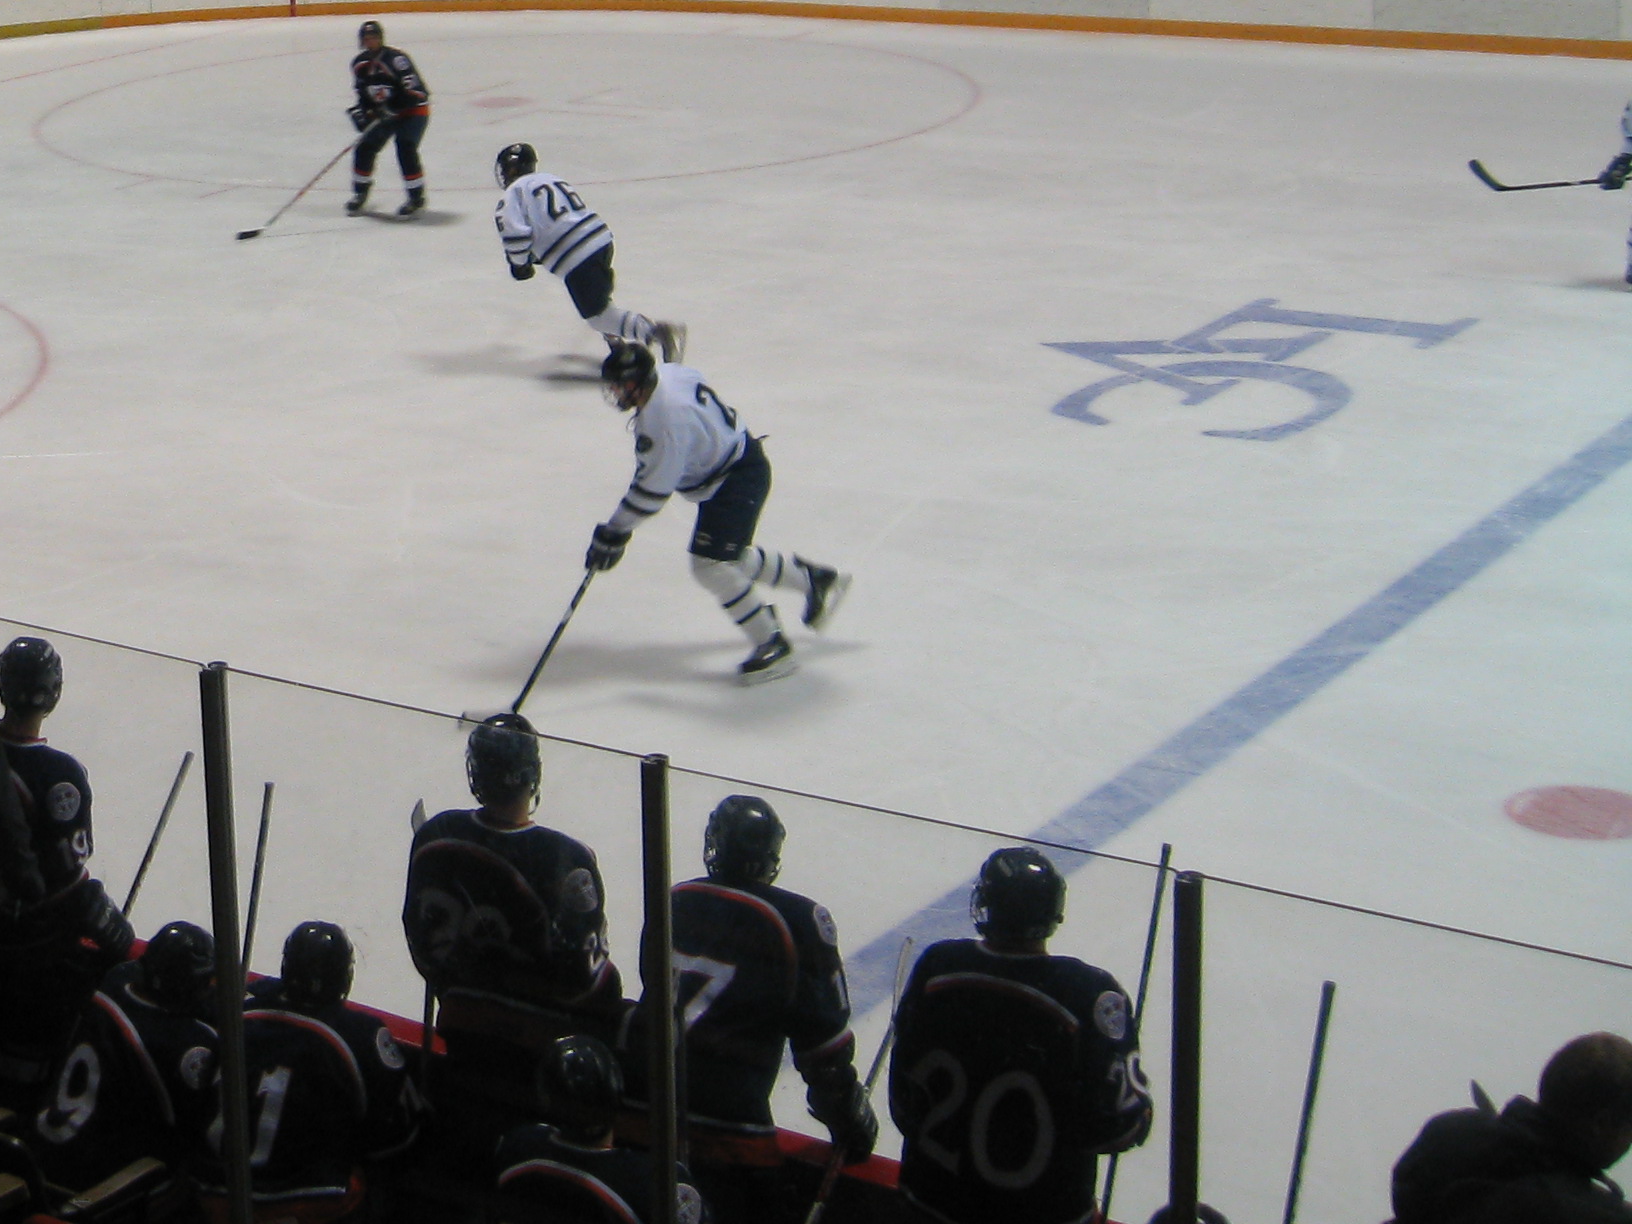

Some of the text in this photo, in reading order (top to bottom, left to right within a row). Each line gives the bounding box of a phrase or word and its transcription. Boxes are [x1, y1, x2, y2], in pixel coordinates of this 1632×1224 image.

[532, 181, 586, 222] 26
[695, 382, 737, 431] 2
[908, 1049, 1058, 1190] 20
